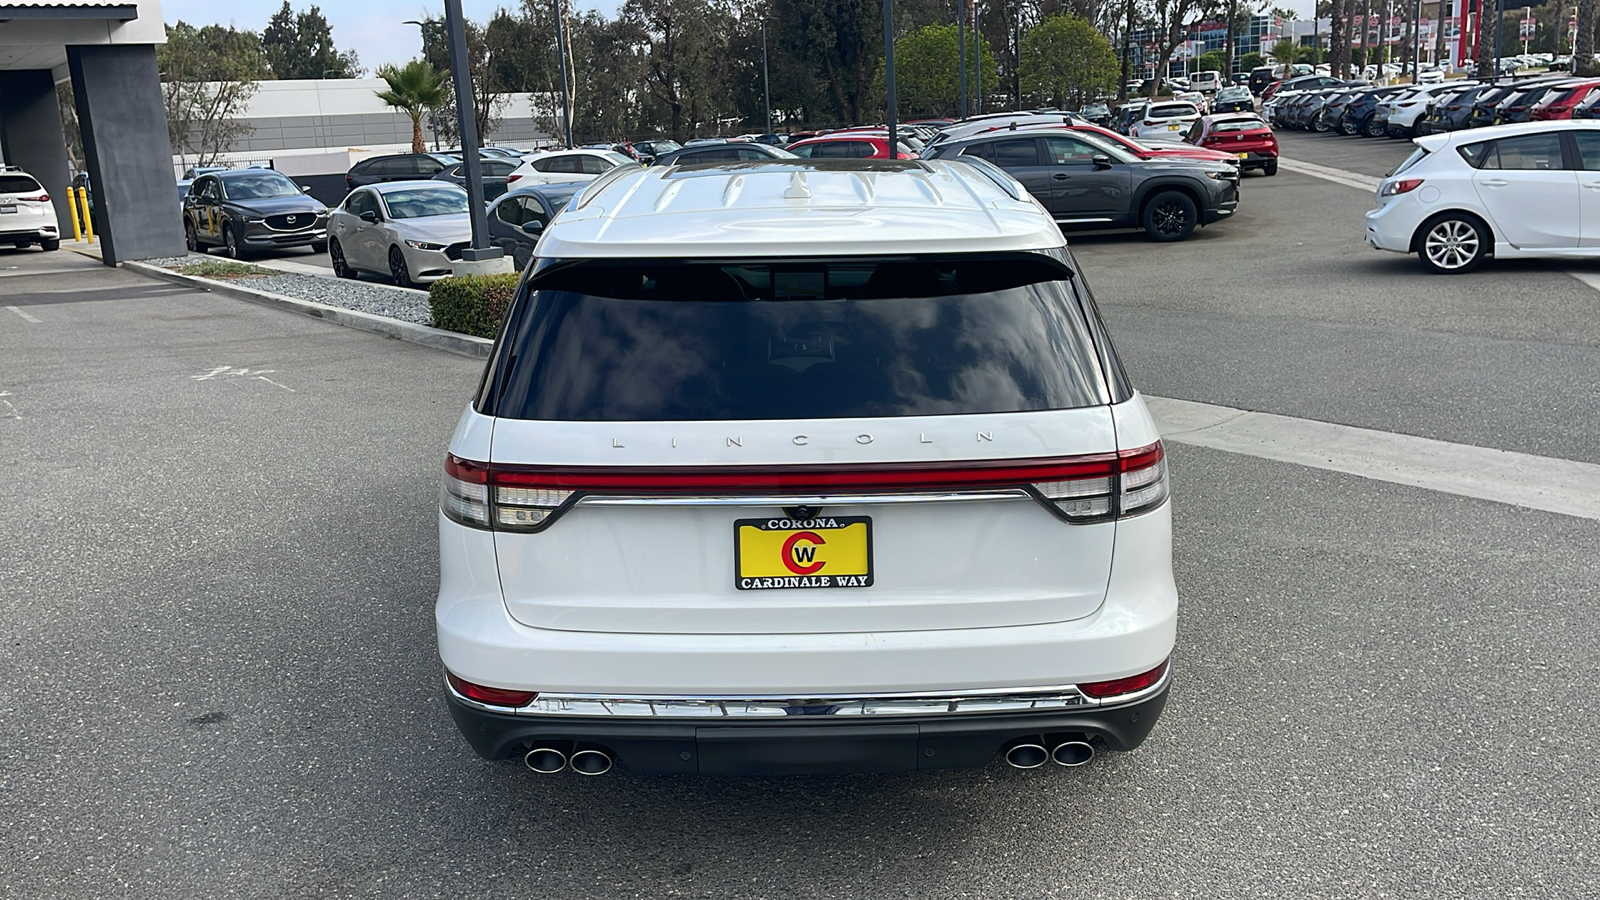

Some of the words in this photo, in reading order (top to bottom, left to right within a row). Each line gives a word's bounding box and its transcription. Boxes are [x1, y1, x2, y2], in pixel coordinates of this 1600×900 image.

[612, 431, 993, 448] LINCOLN
[767, 518, 838, 530] CORONA
[741, 576, 831, 589] CARDINALE
[836, 575, 869, 587] WAY
